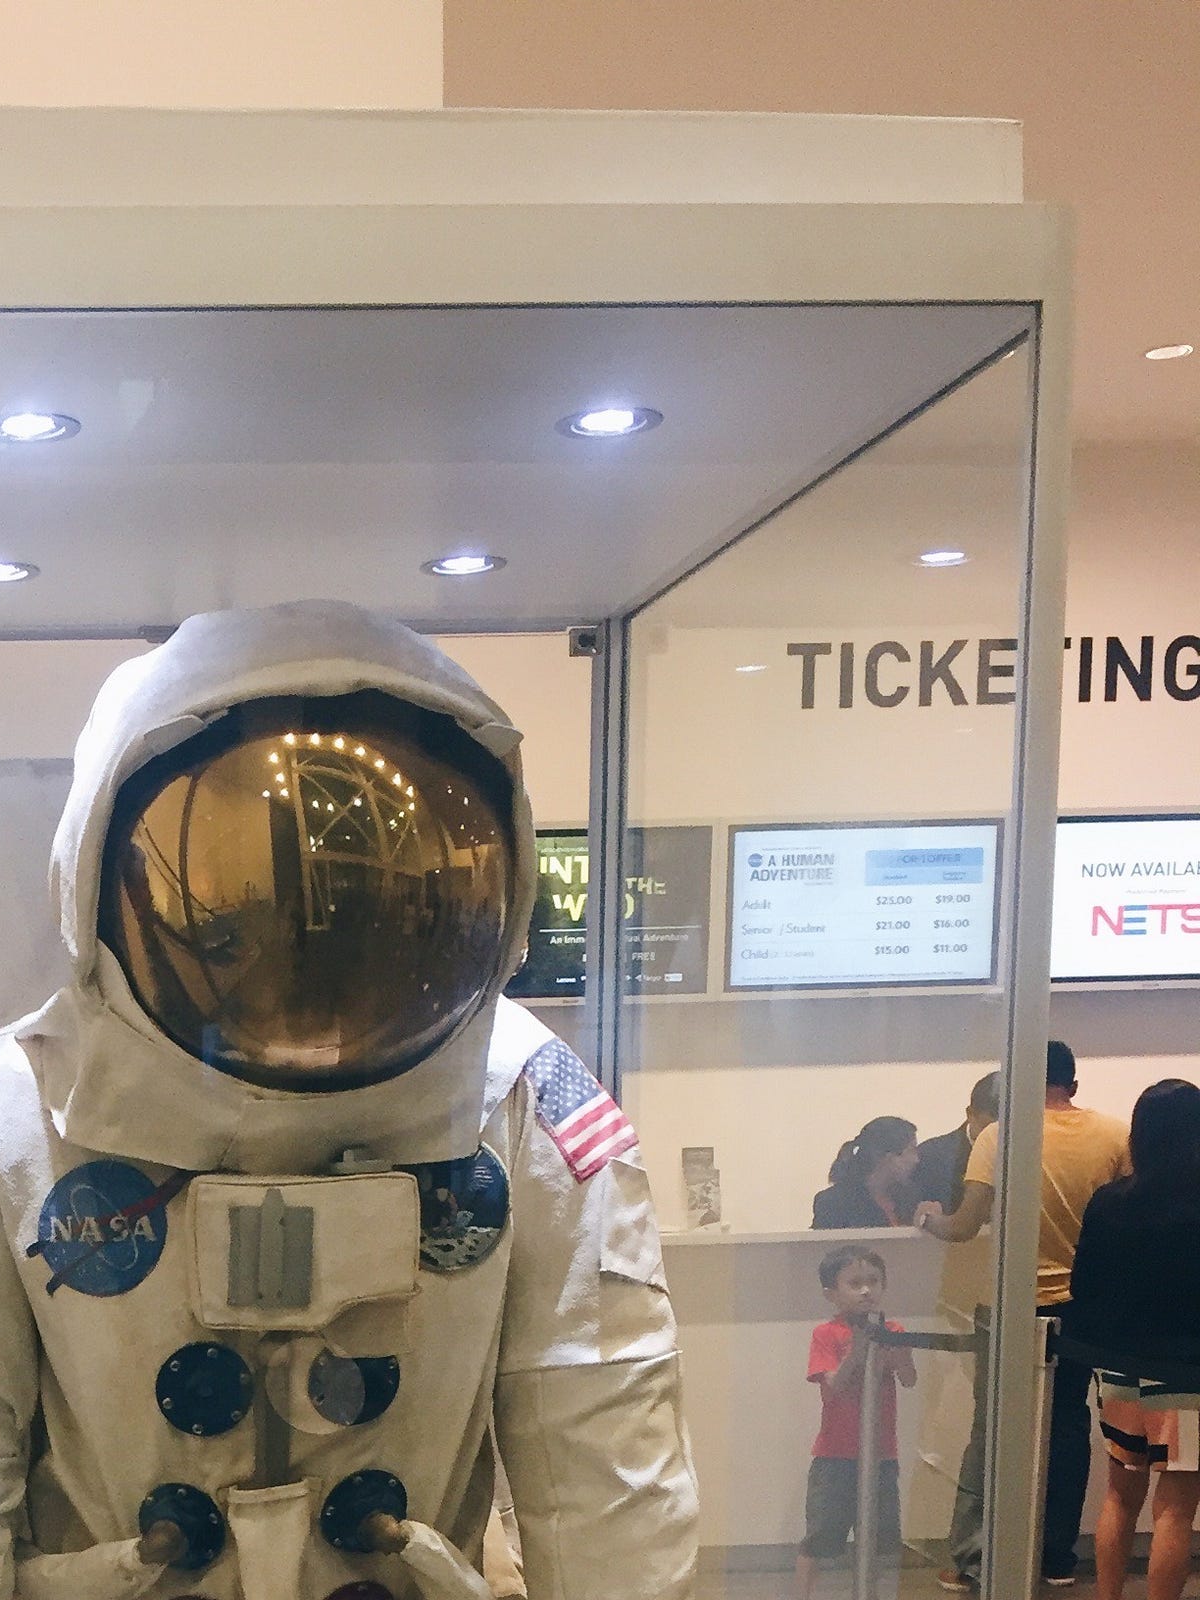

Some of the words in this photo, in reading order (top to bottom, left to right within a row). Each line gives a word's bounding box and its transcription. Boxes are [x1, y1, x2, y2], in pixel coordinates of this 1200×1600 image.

[786, 635, 1200, 709] TICKEING
[767, 855, 776, 867] A
[781, 854, 835, 867] HUMAN
[750, 868, 833, 881] ADVENTURE
[1082, 863, 1126, 877] NOW
[625, 876, 666, 895] THE
[742, 900, 771, 910] Adult
[876, 921, 911, 930] $21.00
[933, 919, 969, 929] $16.00
[1091, 904, 1200, 936] NETS
[741, 949, 769, 959] Child
[874, 946, 910, 955] $15.00
[933, 944, 968, 953] $11.00
[46, 1214, 158, 1243] NASA
